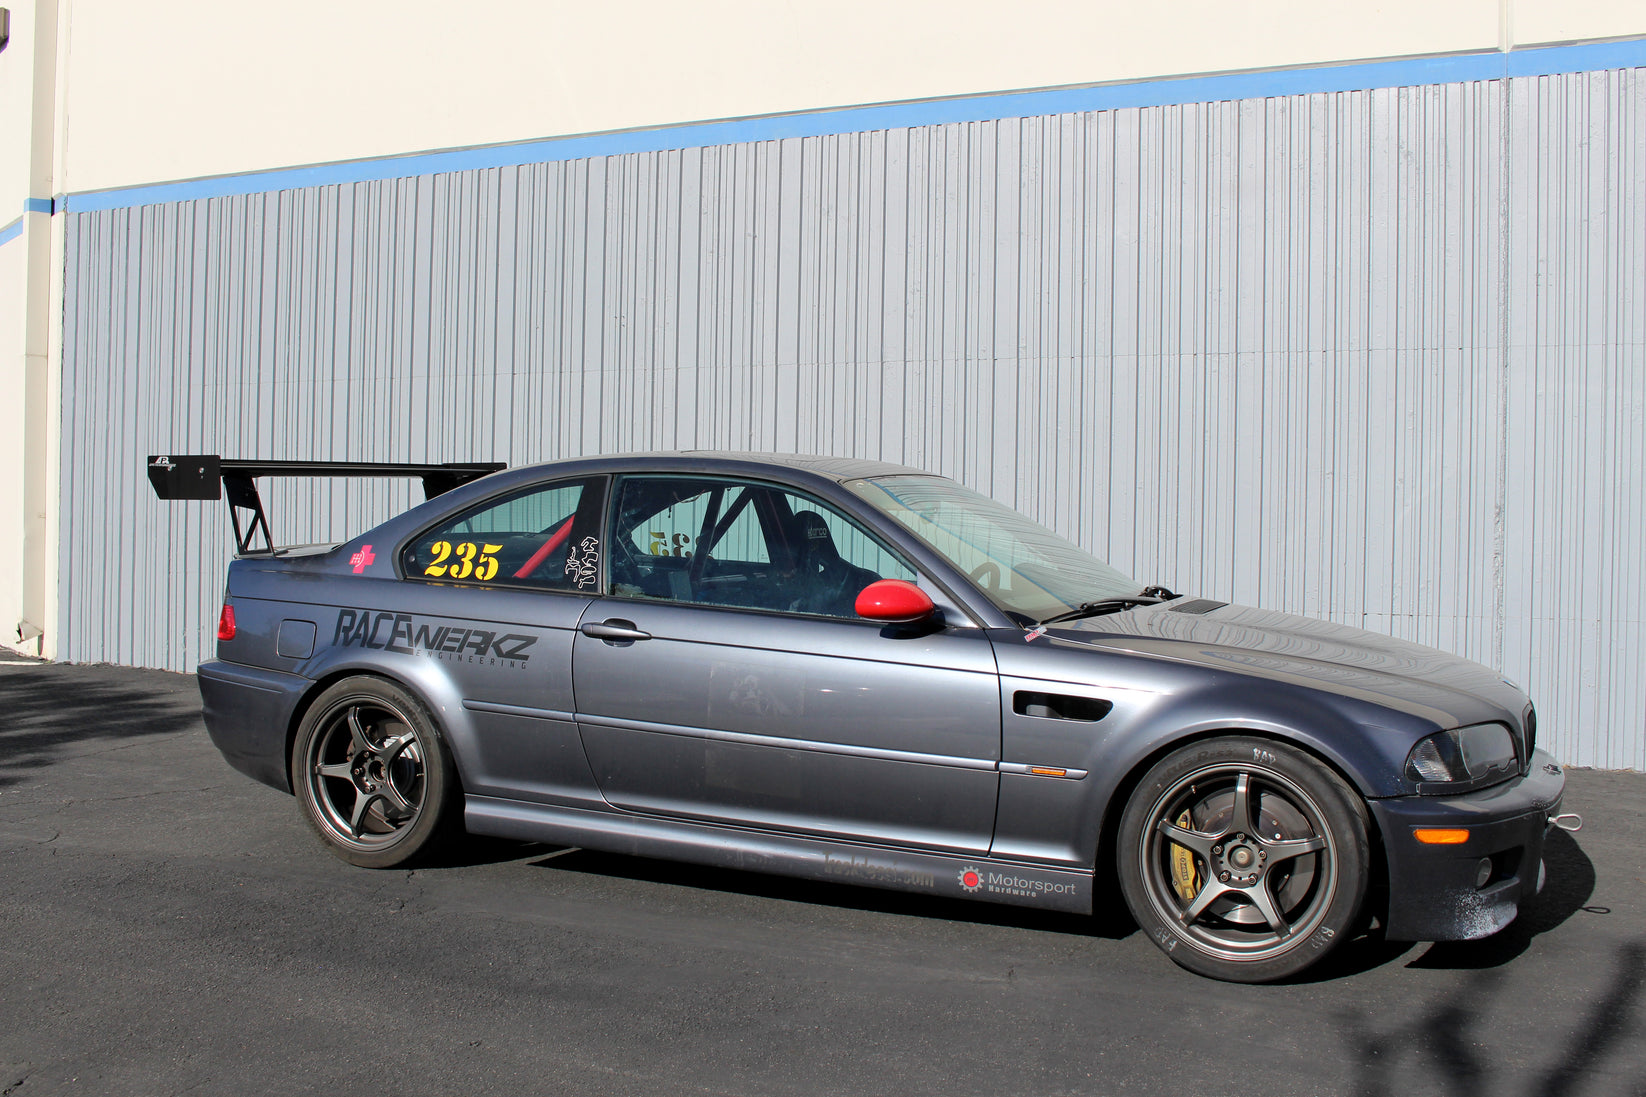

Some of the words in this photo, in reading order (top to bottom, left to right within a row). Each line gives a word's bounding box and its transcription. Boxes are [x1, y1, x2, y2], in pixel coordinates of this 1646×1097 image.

[424, 541, 504, 581] 235
[416, 650, 527, 670] ENGINEERING
[988, 884, 1037, 898] Hardware
[989, 872, 1076, 895] Motorsport
